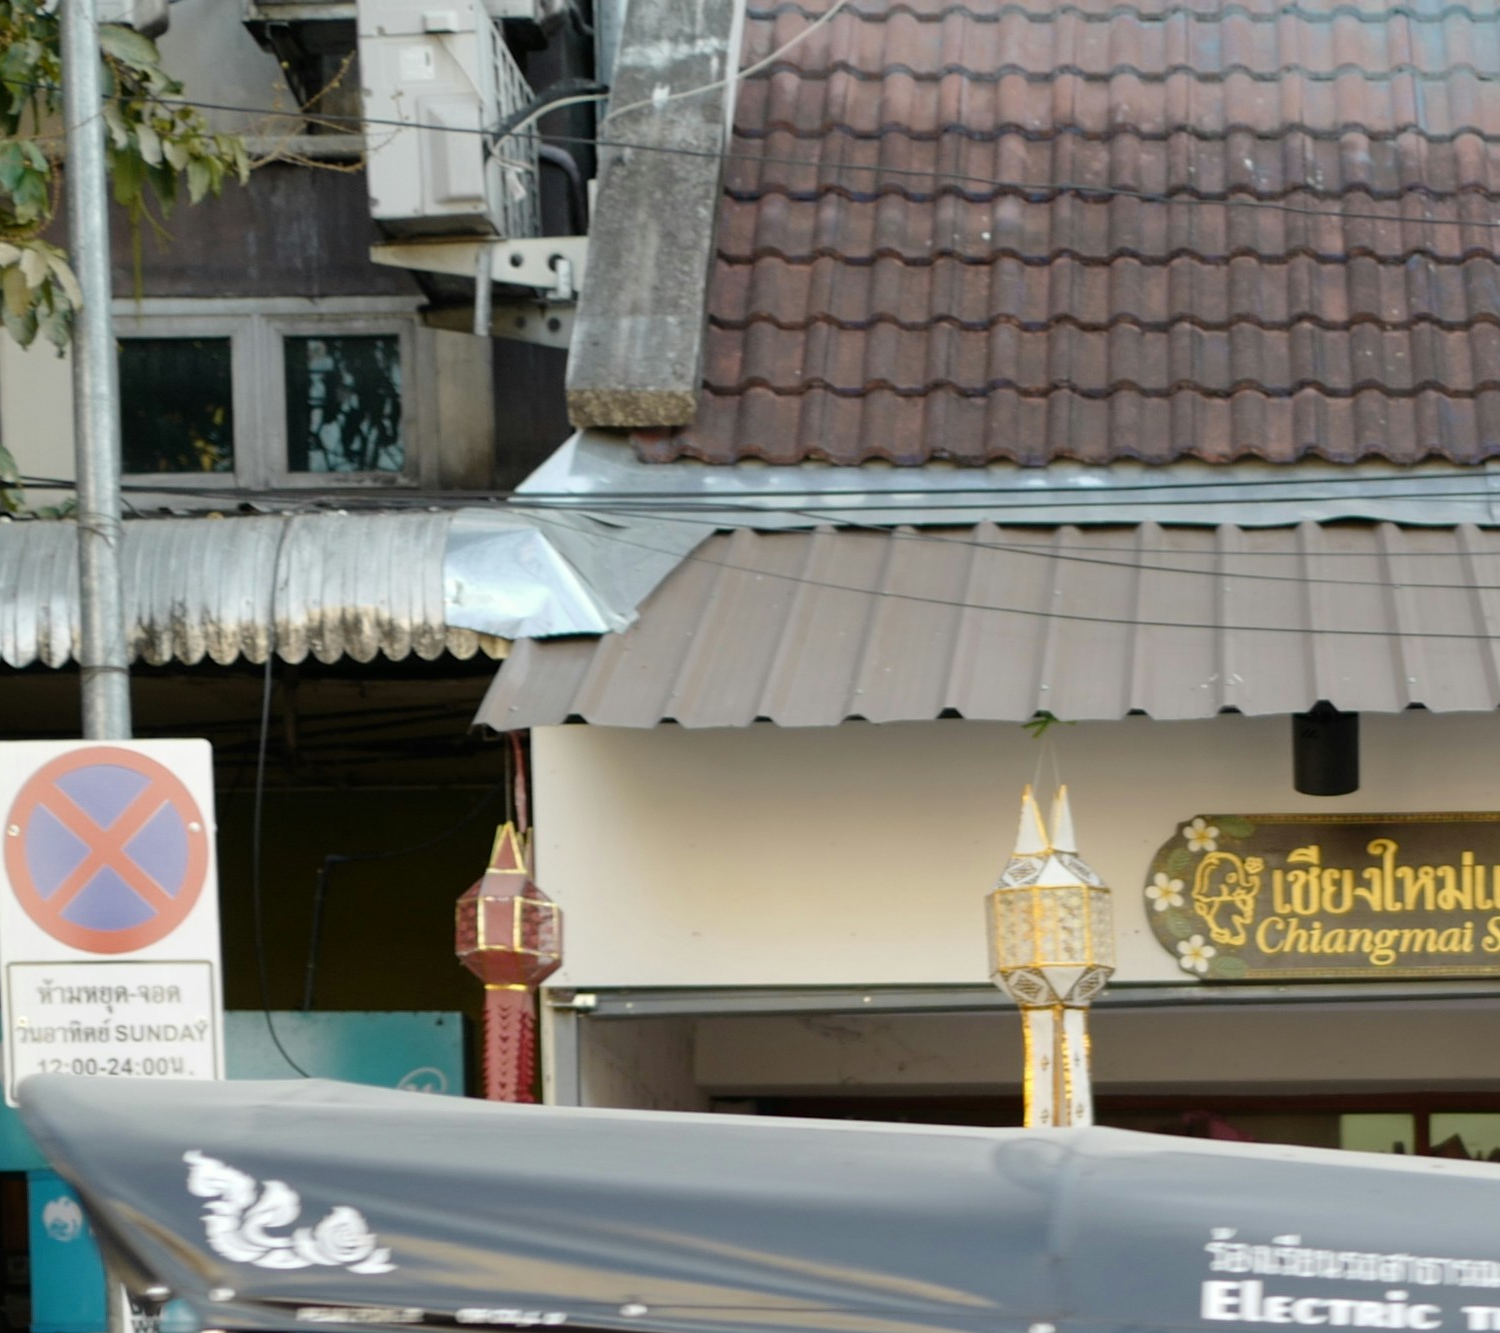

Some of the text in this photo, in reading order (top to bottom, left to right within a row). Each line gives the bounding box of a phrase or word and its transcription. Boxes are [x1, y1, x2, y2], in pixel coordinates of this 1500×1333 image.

[1255, 917, 1474, 967] Chiangmai
[36, 978, 182, 1014] ห้ามหยุด-จอด
[16, 1018, 207, 1044] วนอาทิตย์ SUNDAY
